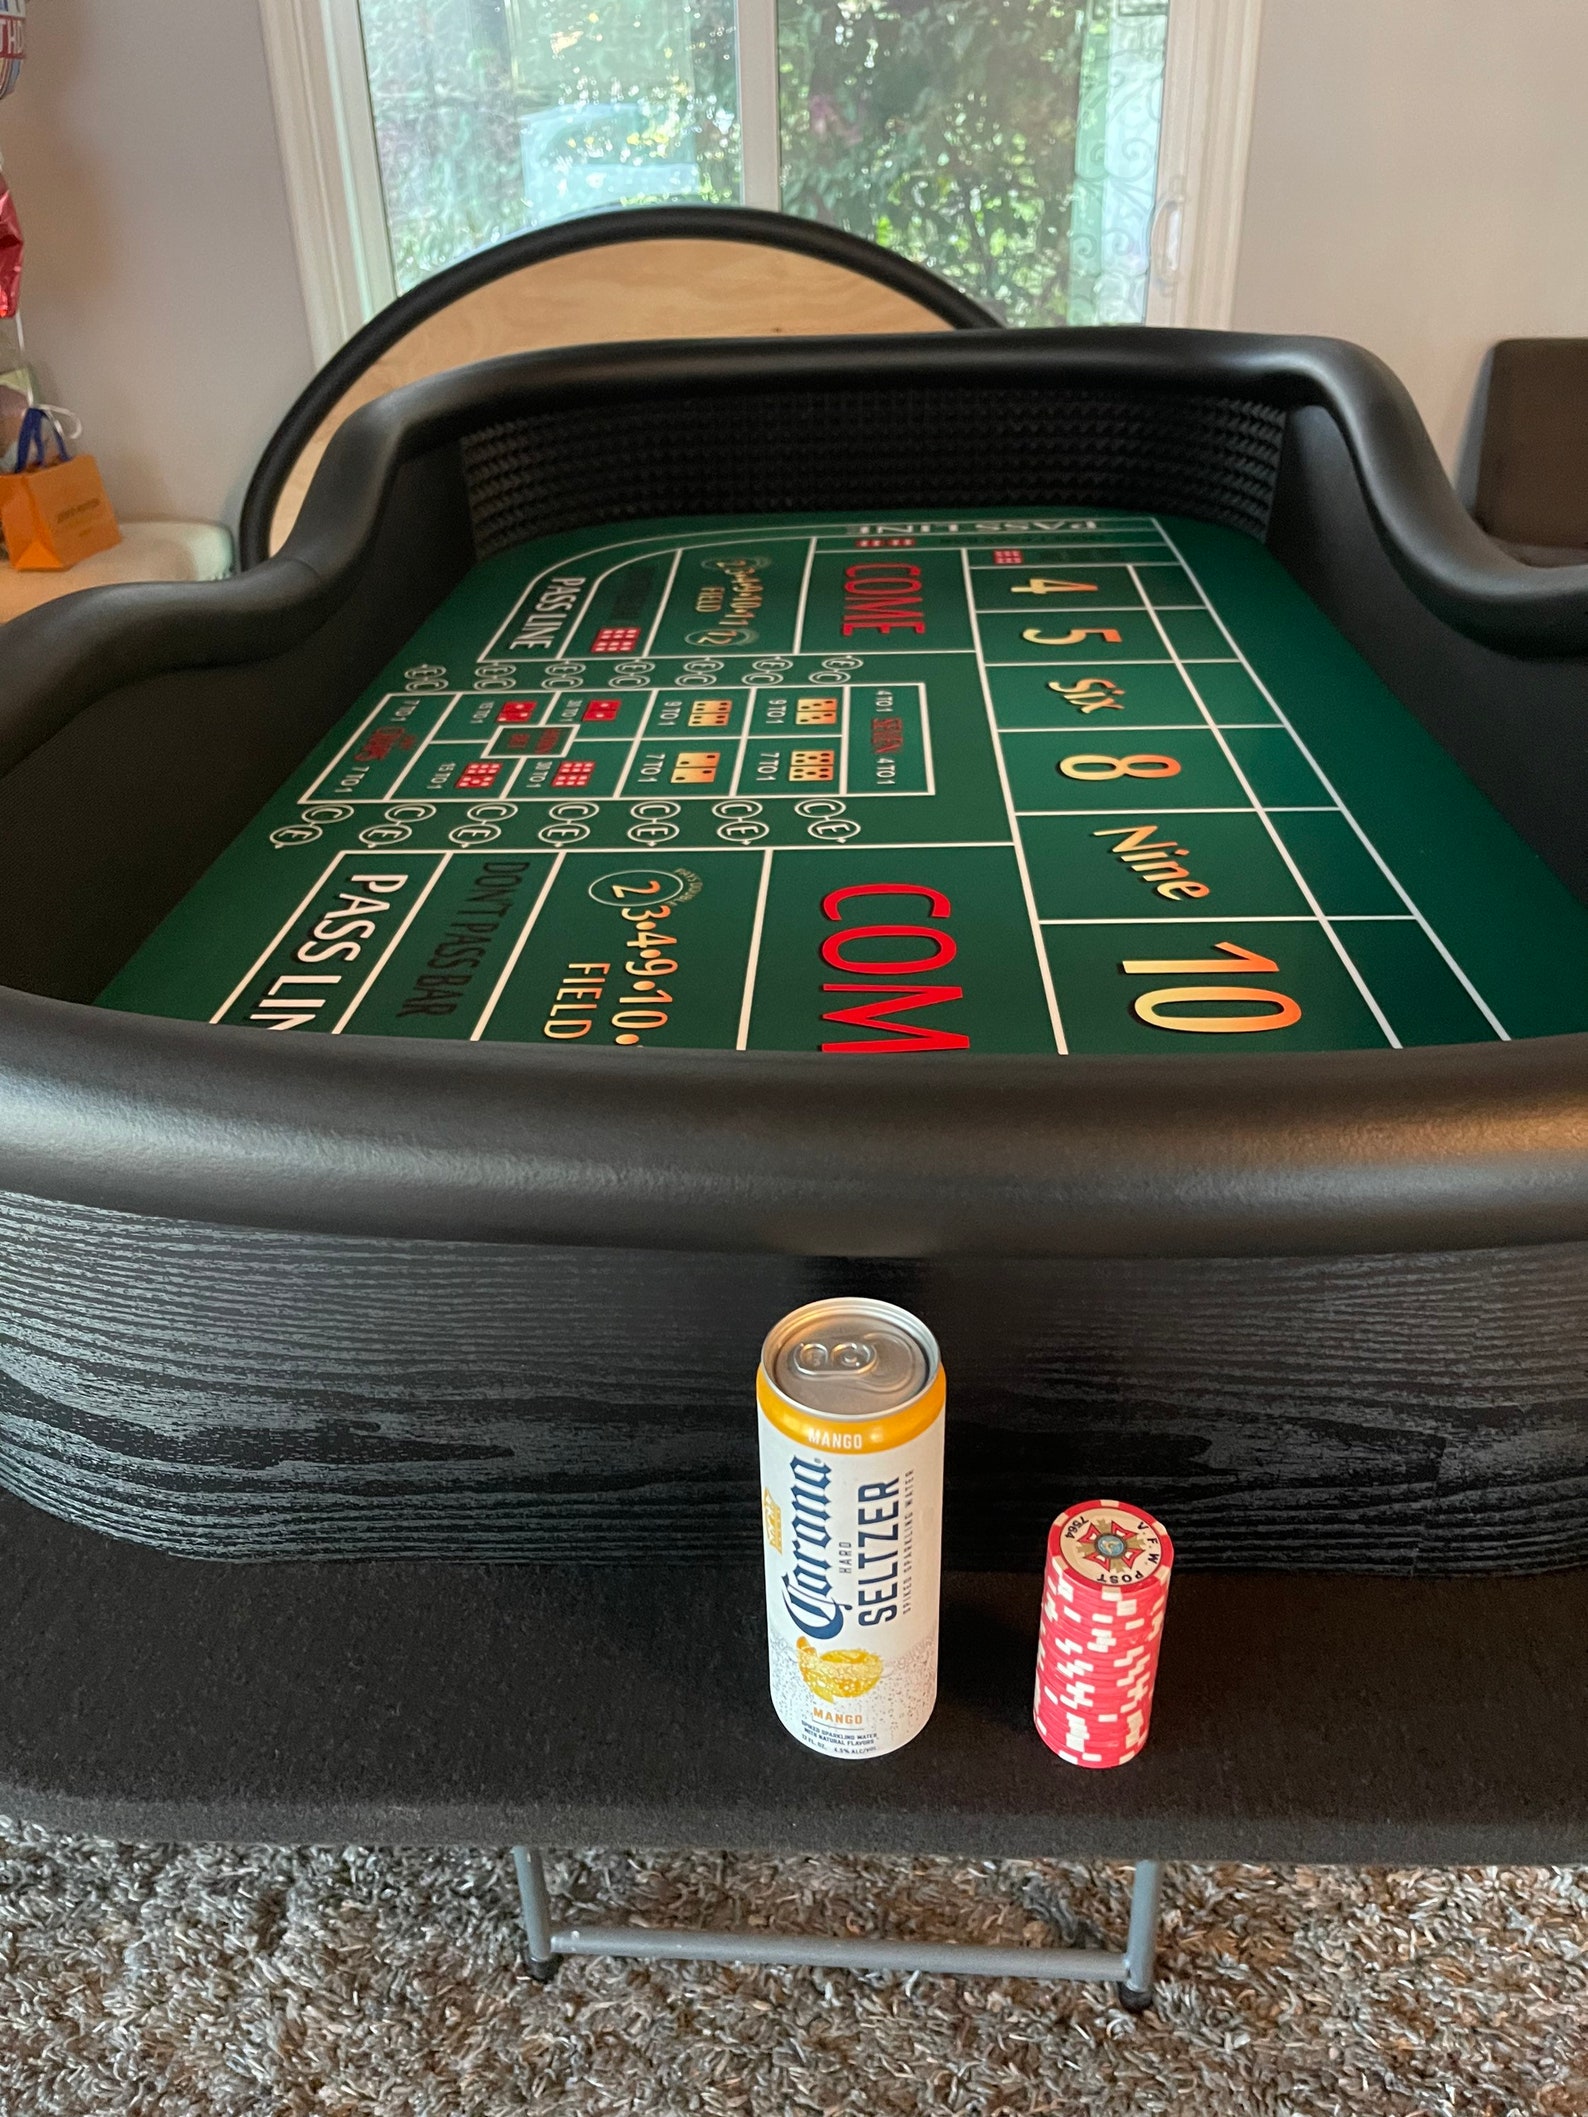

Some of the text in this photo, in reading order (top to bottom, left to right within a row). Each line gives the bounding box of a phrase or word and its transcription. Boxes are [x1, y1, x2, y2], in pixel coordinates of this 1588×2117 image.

[695, 587, 725, 612] FIELD
[842, 562, 926, 637] COME
[1010, 578, 1099, 594] 4
[508, 577, 587, 650] PASS LINE
[697, 630, 737, 644] 12
[1022, 628, 1123, 645] 5
[876, 696, 893, 707] TO
[1048, 677, 1126, 714] Six
[766, 705, 787, 718] TO
[640, 761, 664, 775] TO
[757, 759, 780, 774] TO
[876, 764, 896, 778] TO
[1059, 754, 1182, 781] 8
[1093, 824, 1211, 901] Nine
[612, 880, 661, 898] 2
[297, 874, 408, 963] PASS
[427, 923, 499, 969] PASS
[821, 882, 970, 1053] COM
[395, 974, 473, 1018] BAR
[543, 963, 611, 1039] FIELD
[1122, 941, 1303, 1033] 10
[807, 1430, 863, 1449] MANGO
[781, 1455, 853, 1640] Corona
[858, 1476, 899, 1626] SELTZER
[902, 1469, 914, 1615] SPIKED SPARKLING WATER
[838, 1541, 852, 1574] HARD
[1097, 1570, 1144, 1584] POST
[813, 1707, 863, 1724] MANGO
